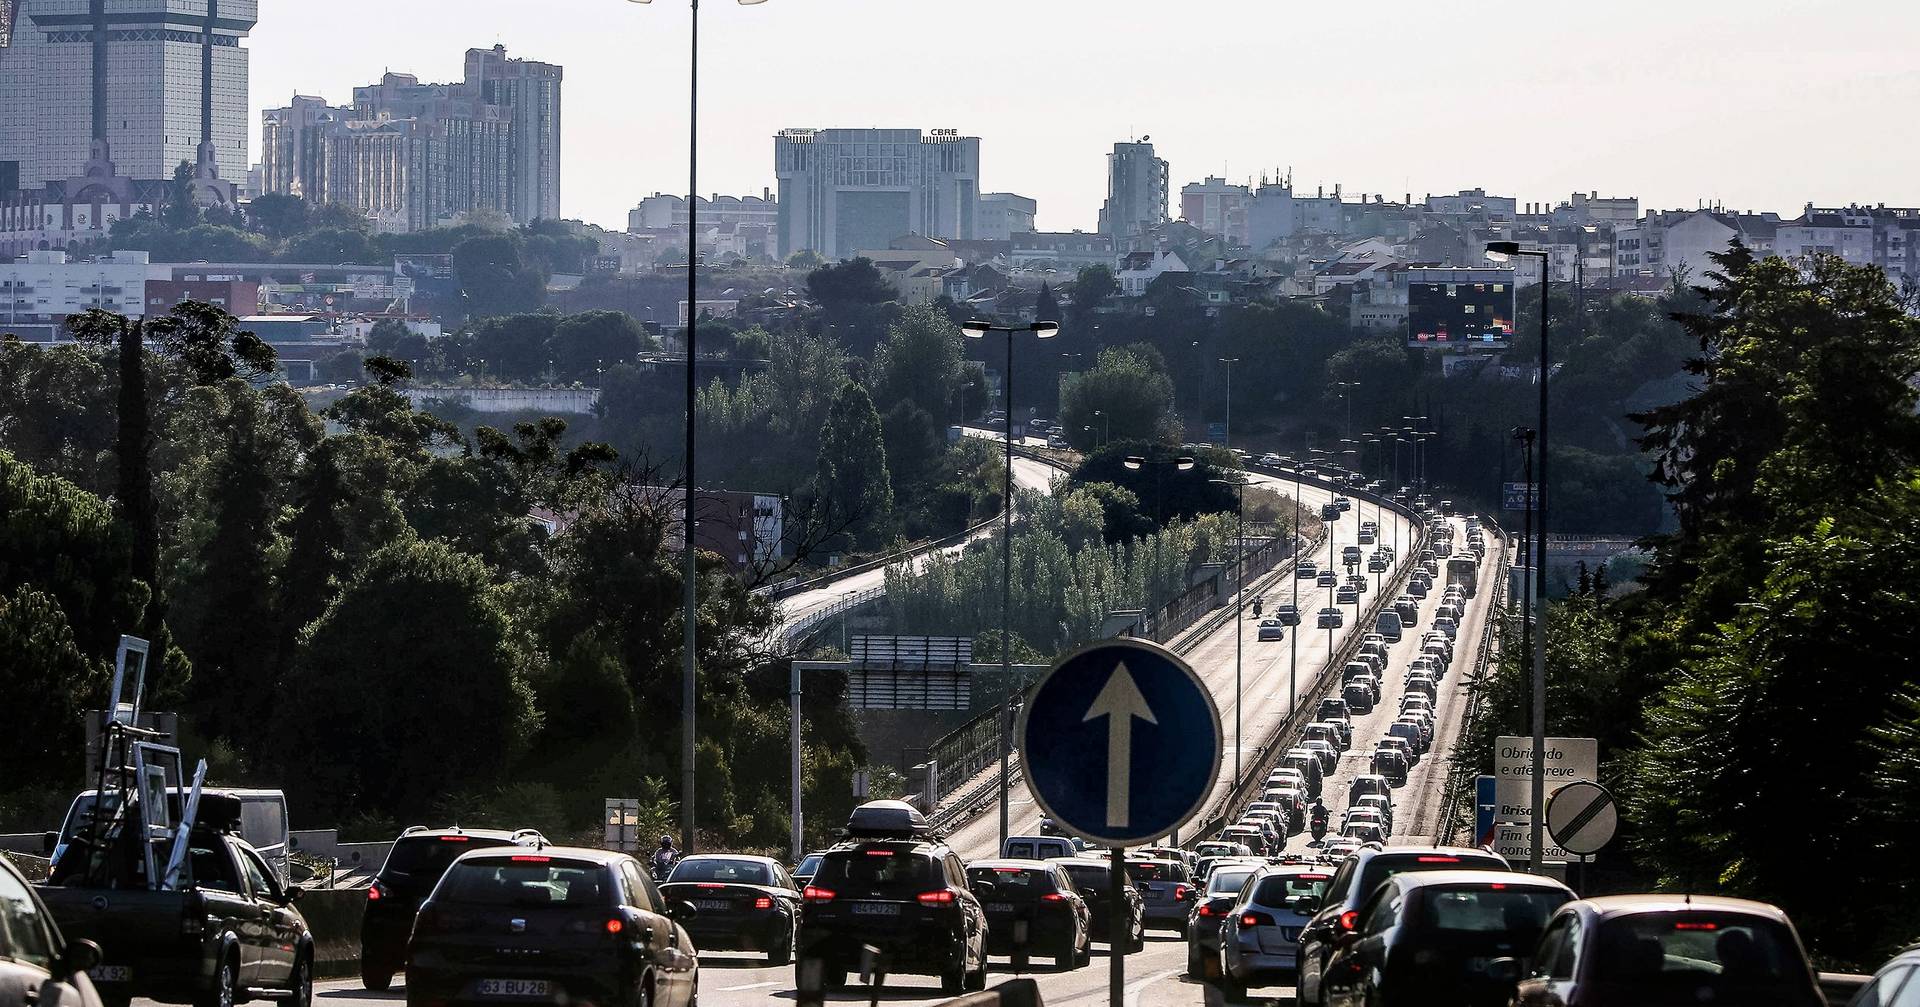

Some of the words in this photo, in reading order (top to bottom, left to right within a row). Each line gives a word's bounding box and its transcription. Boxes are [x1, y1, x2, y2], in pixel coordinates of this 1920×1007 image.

[931, 128, 958, 136] CBRE
[1501, 766, 1510, 775] e
[1500, 829, 1523, 841] Fim
